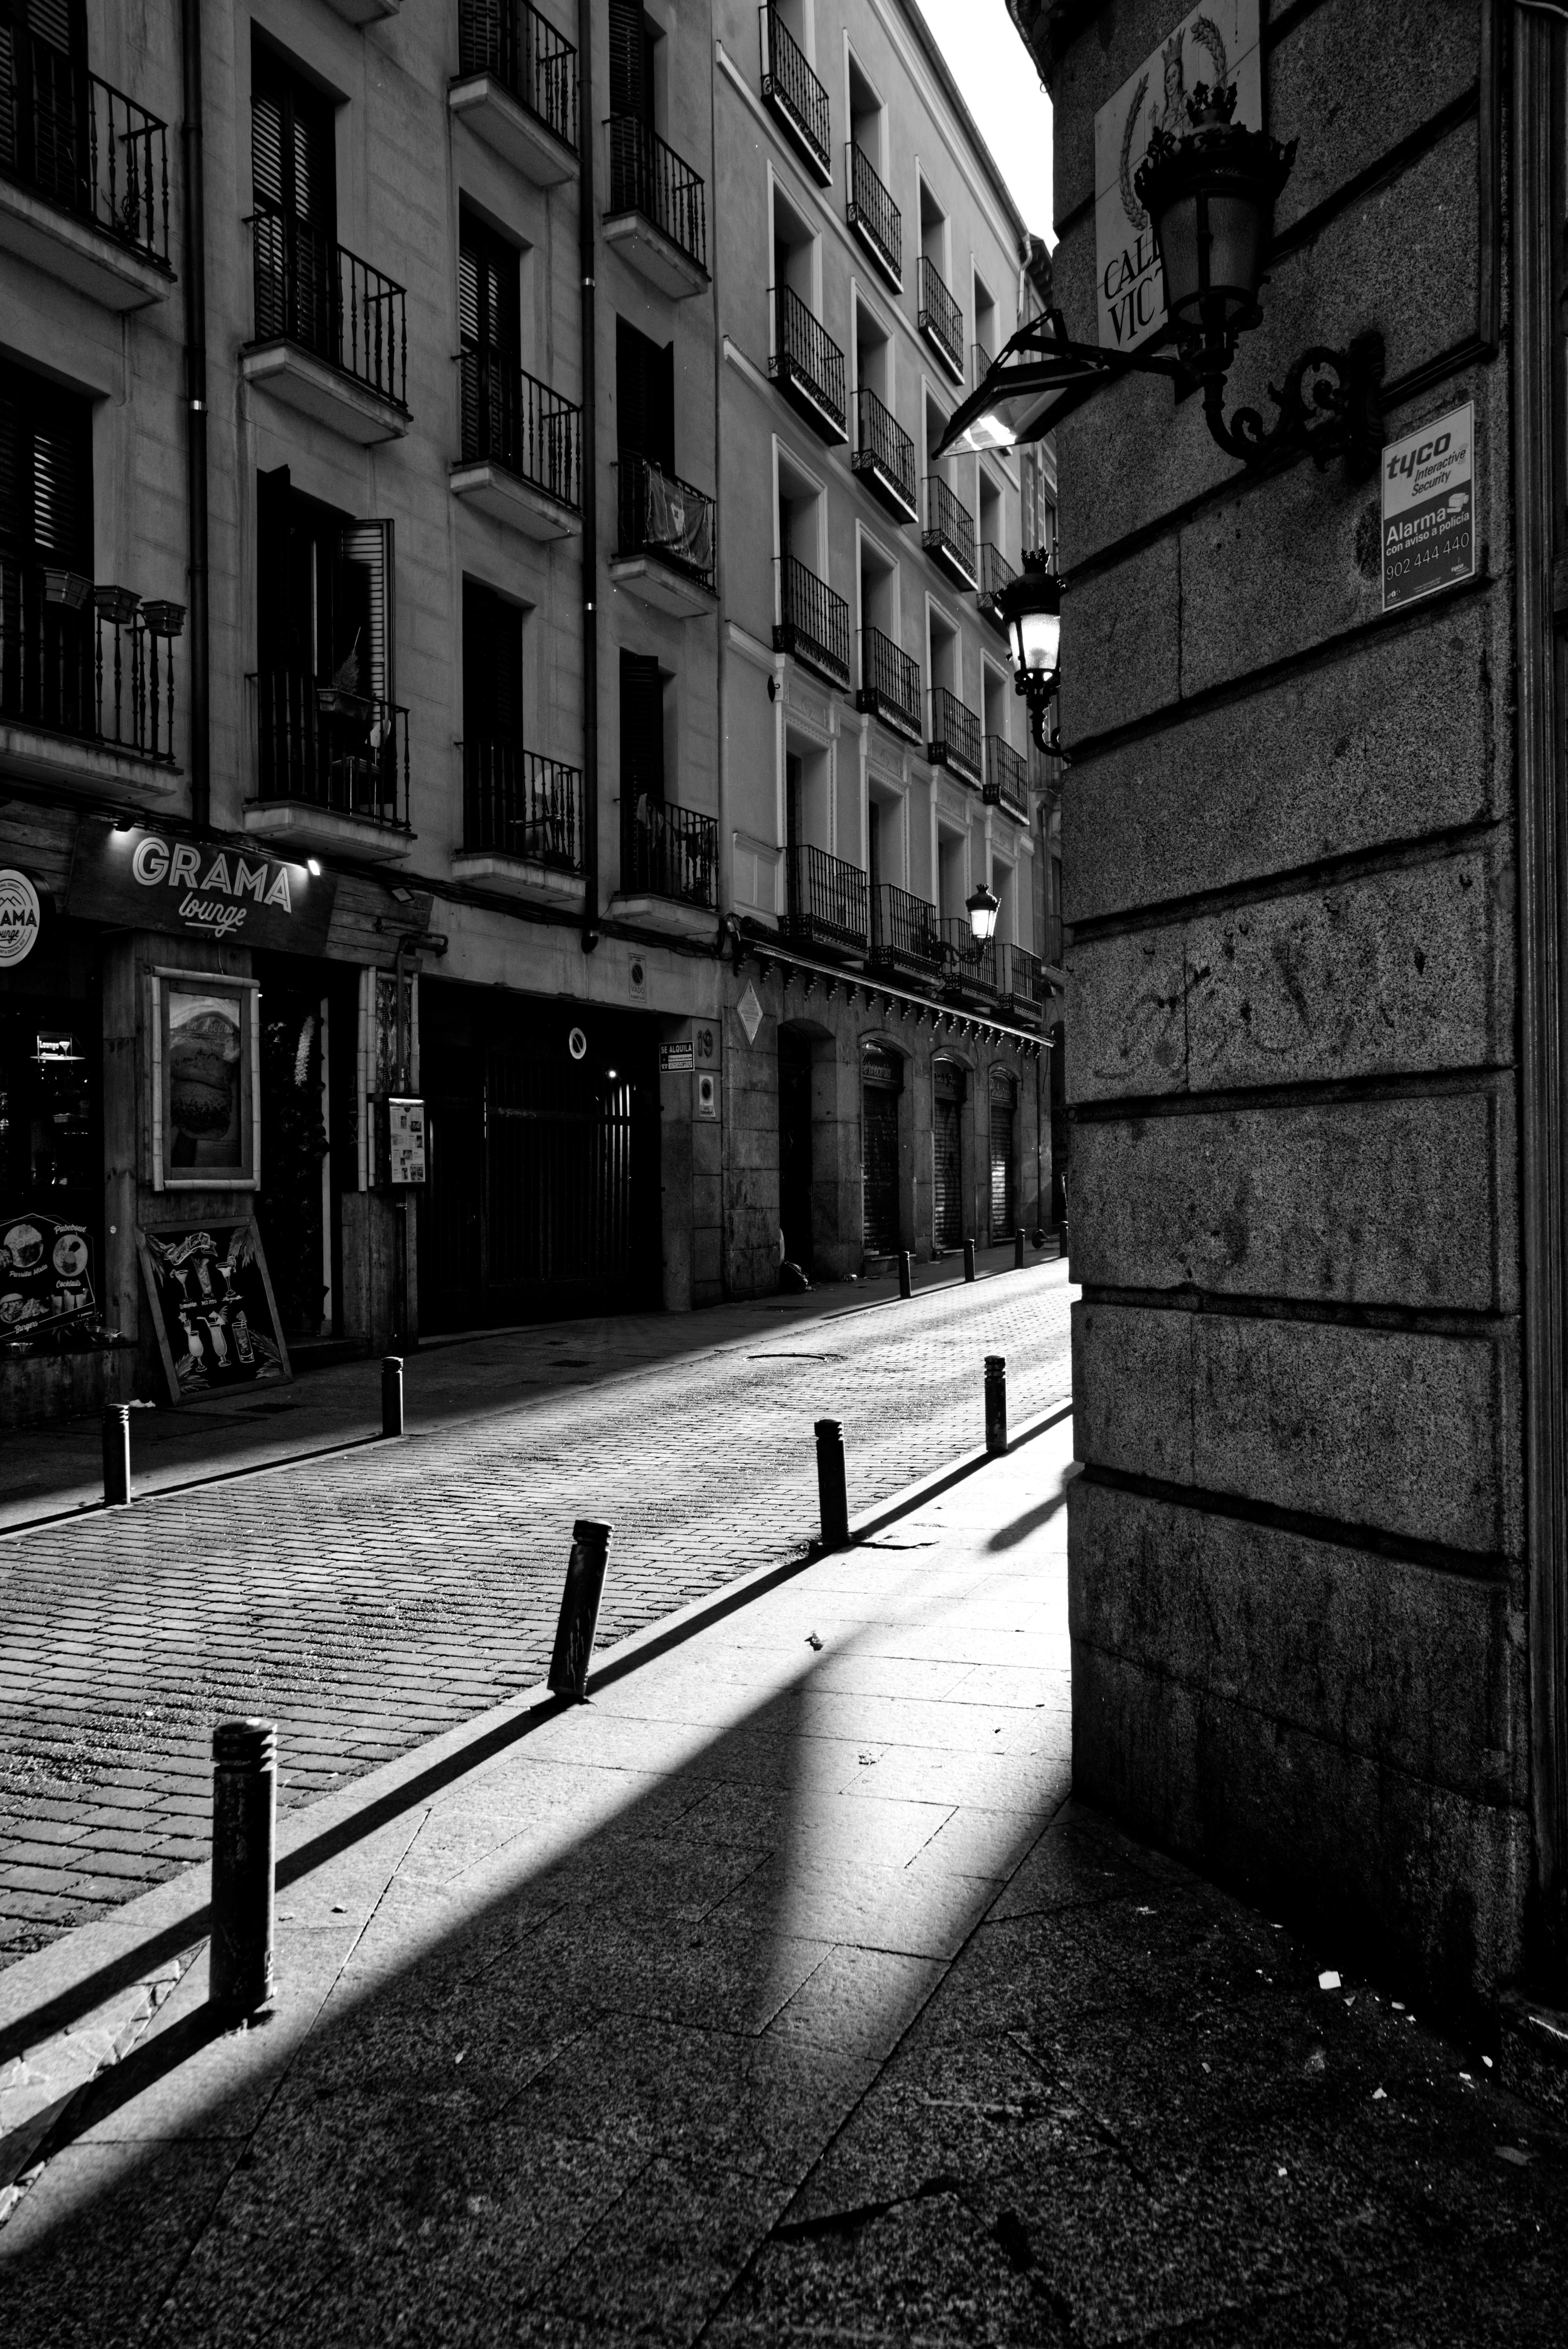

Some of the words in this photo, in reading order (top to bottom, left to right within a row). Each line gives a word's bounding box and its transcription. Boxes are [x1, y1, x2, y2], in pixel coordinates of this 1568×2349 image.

[1105, 225, 1162, 299] CALL
[1108, 265, 1168, 346] VICT
[1387, 433, 1451, 480] tyco
[1414, 449, 1466, 483] Interactive
[1412, 470, 1451, 497] Security
[1386, 507, 1446, 546] Alarma
[1386, 542, 1403, 556] con
[1405, 531, 1429, 548] aviso
[1431, 527, 1437, 536] a
[1439, 511, 1470, 535] policía
[1387, 558, 1411, 580] 902
[1414, 545, 1440, 567] 444
[1443, 532, 1470, 554] 440
[1451, 563, 1464, 572] tyco
[132, 837, 292, 914] GRAMA
[0, 909, 37, 927] AMA
[179, 891, 247, 938] lounge
[0, 930, 19, 944] unge
[631, 985, 645, 994] VADO
[661, 1046, 668, 1054] SE
[669, 1044, 692, 1053] ALQUILA
[697, 1029, 712, 1057] 19
[56, 1279, 81, 1289] Cocktails
[14, 1320, 39, 1334] Burgers
